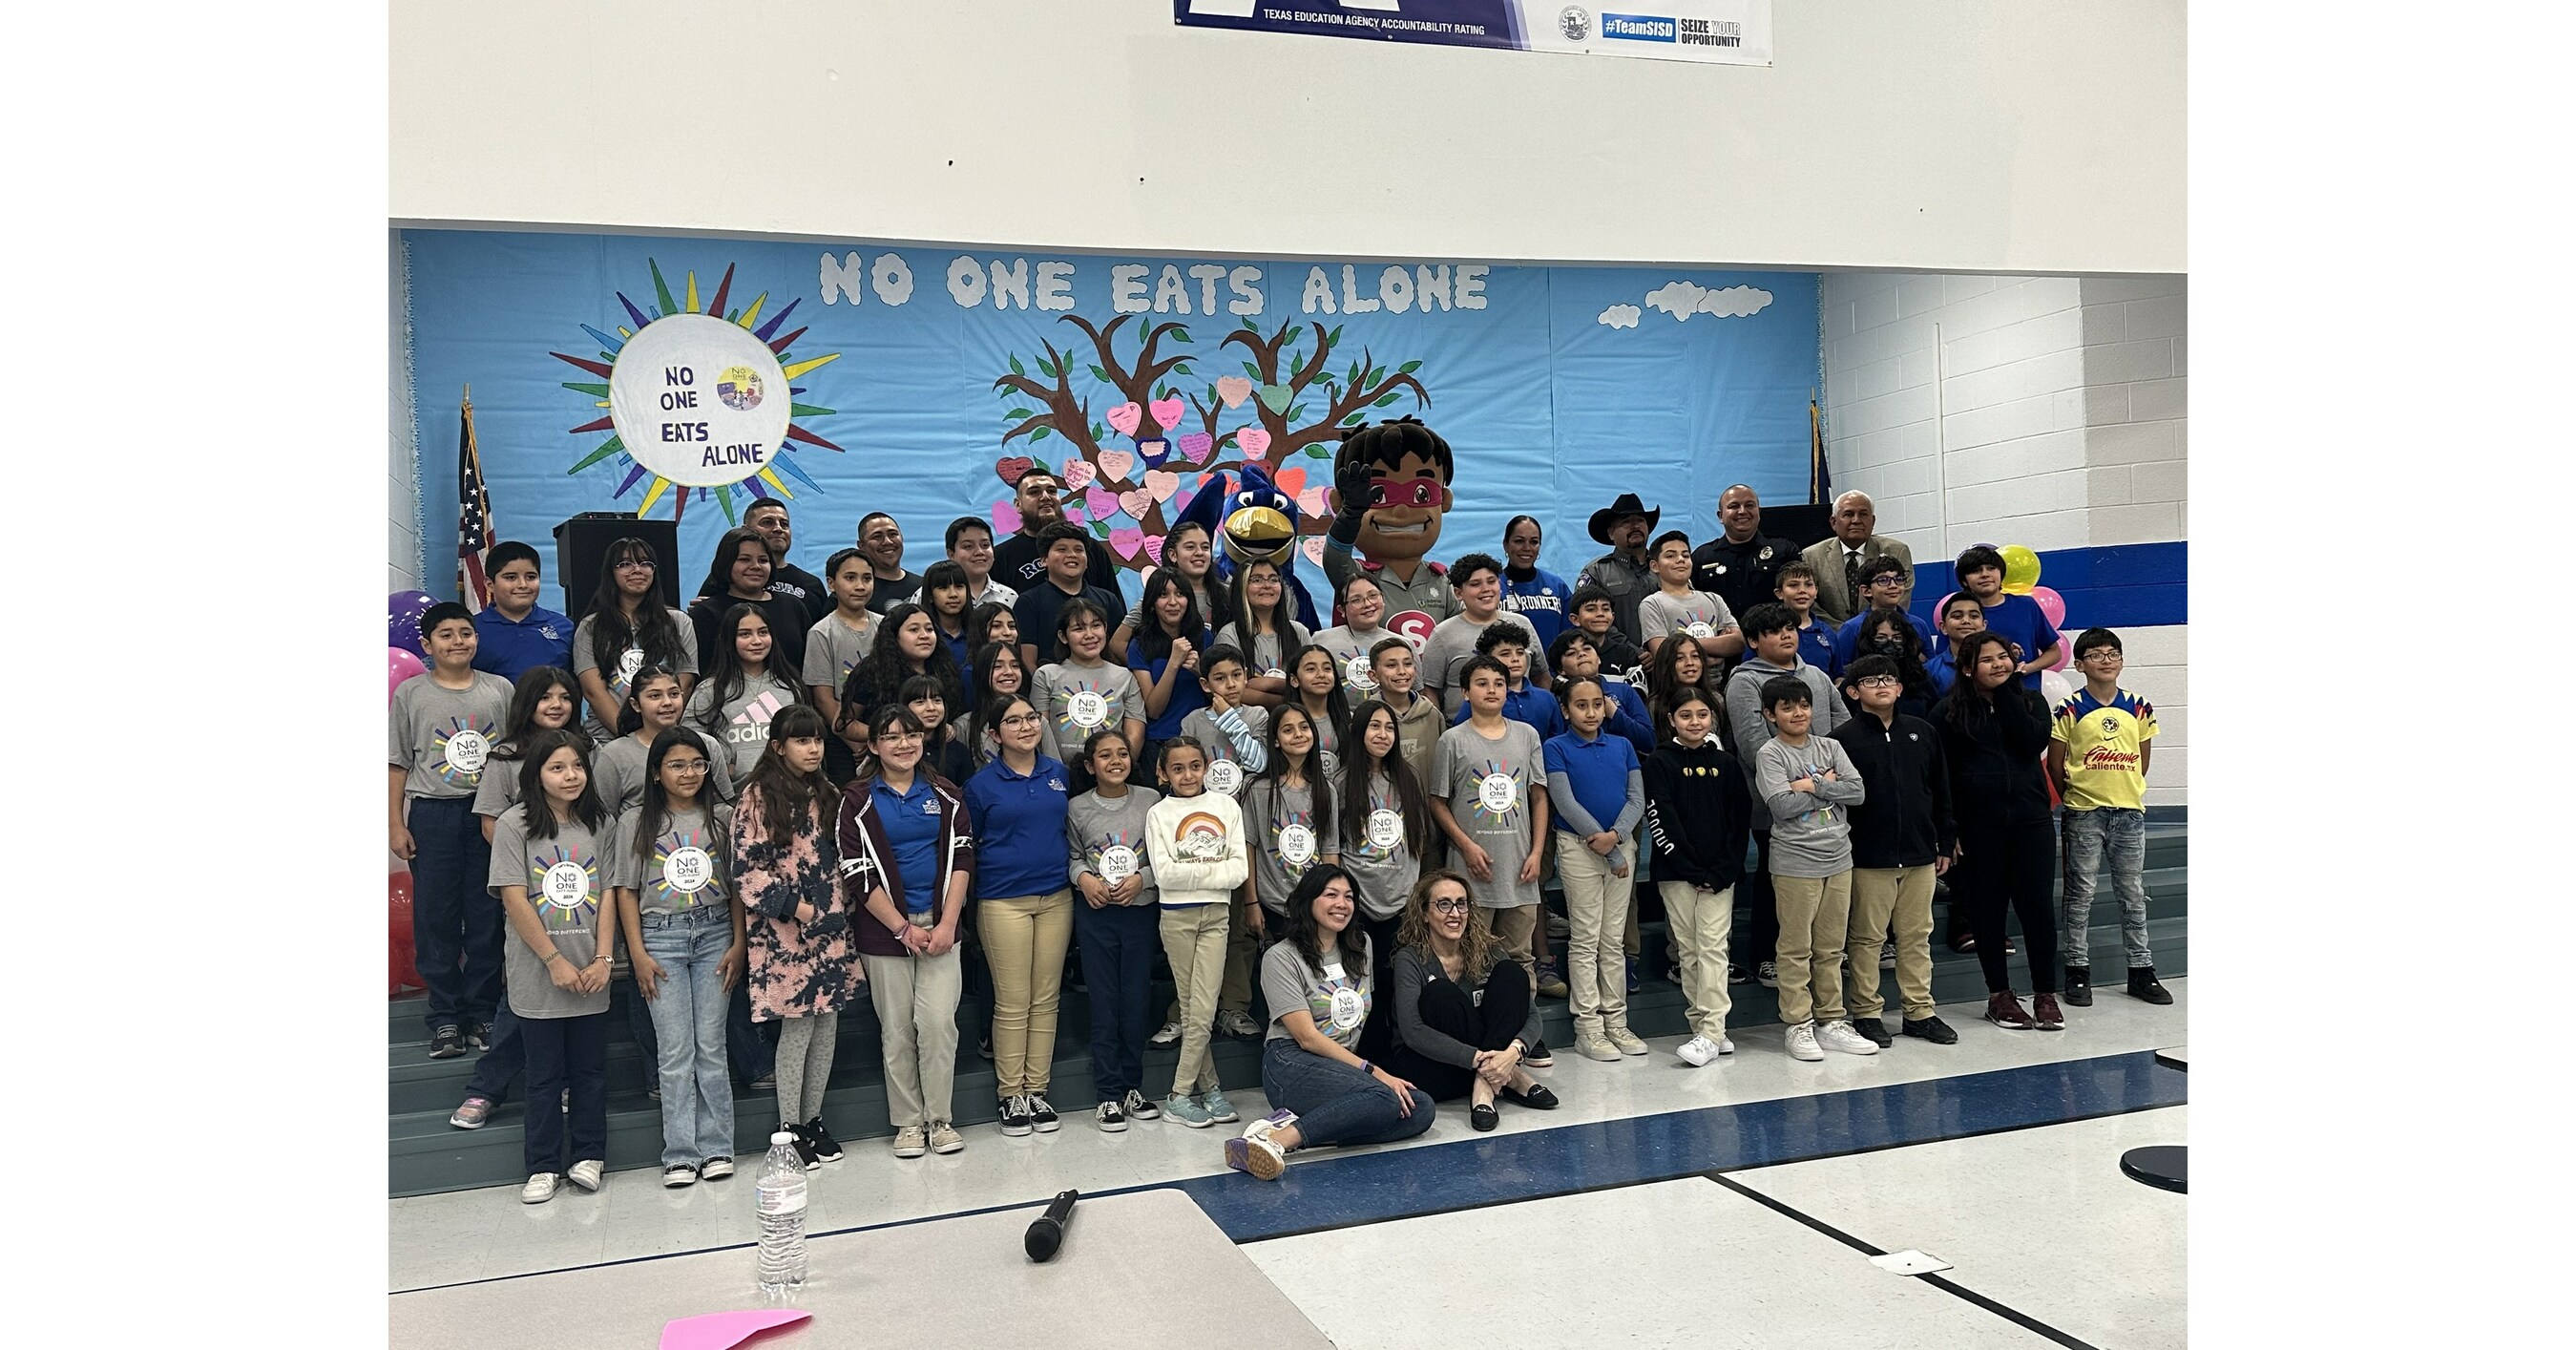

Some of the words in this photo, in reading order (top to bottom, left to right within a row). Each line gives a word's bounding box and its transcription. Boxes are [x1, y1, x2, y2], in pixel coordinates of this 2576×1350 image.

[1263, 9, 1292, 21] TEXAS
[1294, 11, 1344, 25] EDUCATION
[1345, 15, 1380, 29] AGENCY
[1381, 19, 1453, 33] ACCOUNTABILITY
[1455, 23, 1485, 35] RATING
[1605, 18, 1673, 37] #TeamSISD
[1681, 18, 1709, 33] SEIZE
[1711, 21, 1741, 35] YOUR
[1681, 33, 1741, 48] OPPORTUNITY
[819, 250, 914, 306] NO
[947, 254, 1077, 311] ONE
[1111, 263, 1266, 316] EATS
[1301, 264, 1491, 315] ALONE
[665, 367, 694, 386] NO
[660, 390, 698, 411] ONE
[661, 422, 709, 442] EATS
[702, 443, 764, 467] ALONE
[1018, 558, 1046, 580] RO
[1078, 698, 1097, 707] NO
[726, 721, 770, 744] adi
[456, 739, 478, 750] NO
[1212, 768, 1230, 776] NO
[1489, 782, 1507, 791] NO
[1374, 818, 1393, 829] NO
[1288, 833, 1304, 842] NO
[676, 857, 699, 868] NO
[1108, 855, 1128, 865] NO
[555, 872, 577, 882] NO
[1338, 996, 1354, 1007] NO
